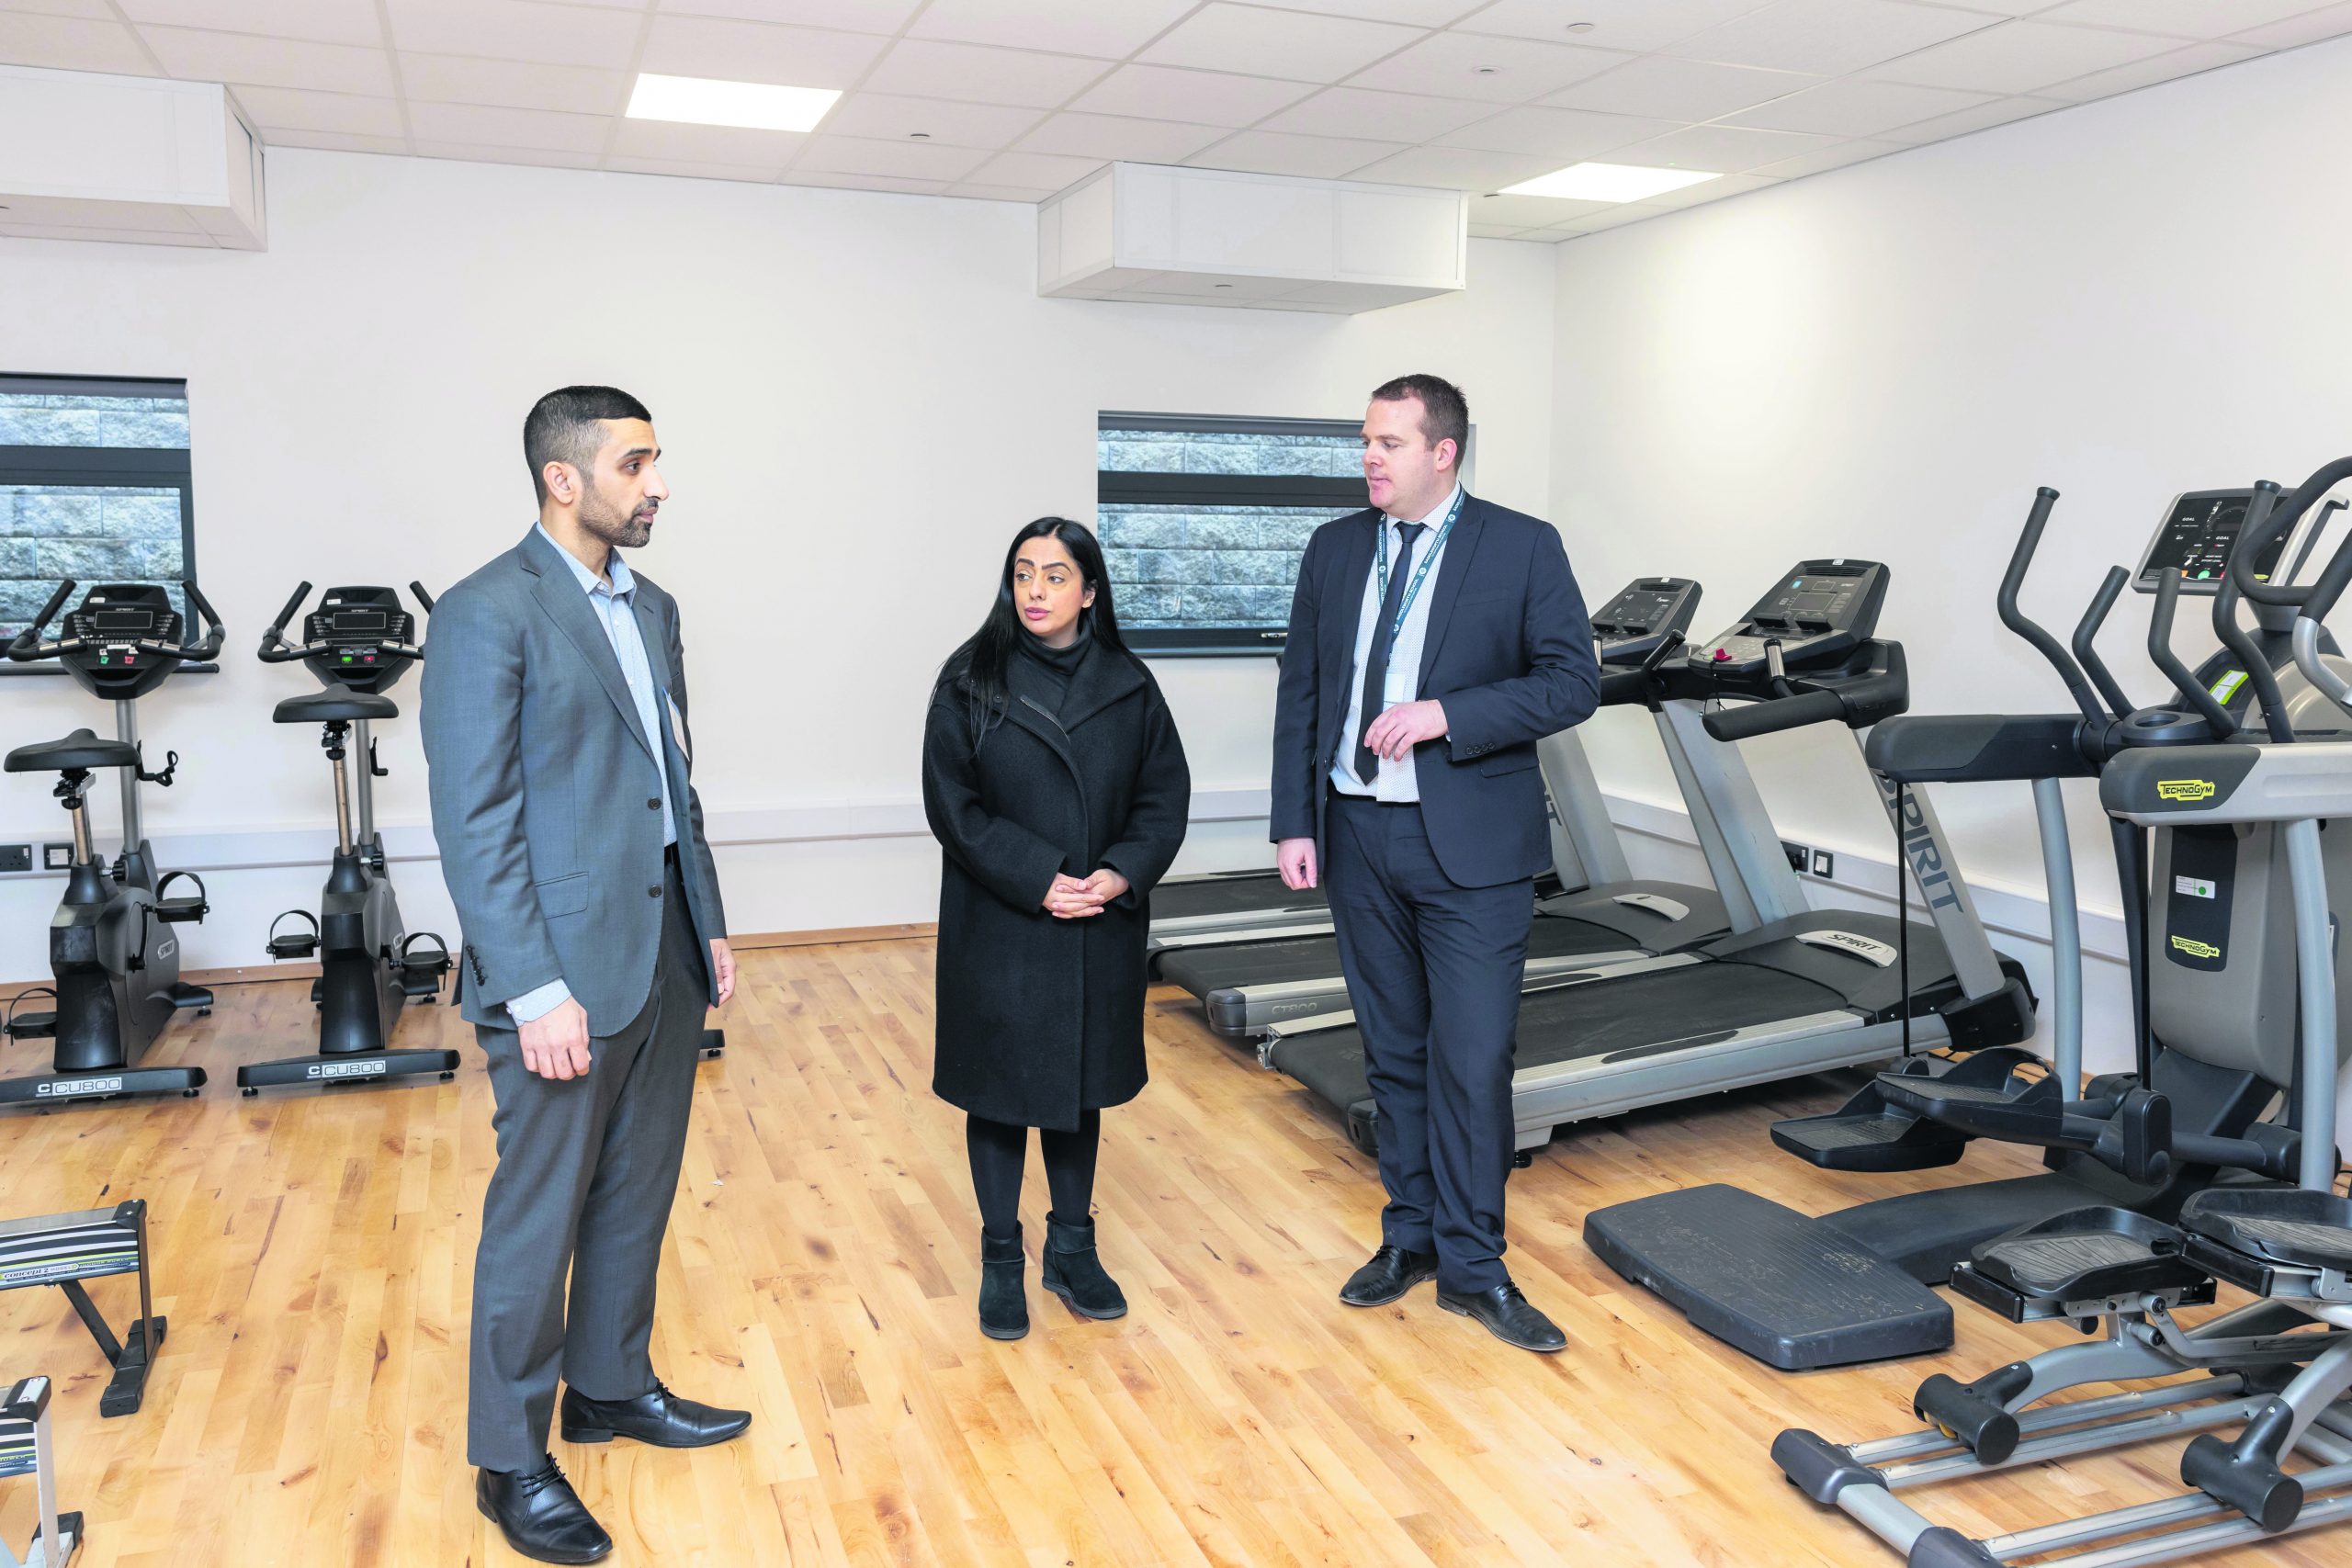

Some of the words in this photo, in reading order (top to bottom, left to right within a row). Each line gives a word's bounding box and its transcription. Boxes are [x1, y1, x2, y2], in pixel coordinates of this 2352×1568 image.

[1826, 934, 1882, 950] SPIRIT
[1272, 1002, 1317, 1014] CT800
[324, 1062, 384, 1076] CU800
[55, 1079, 120, 1093] CU800
